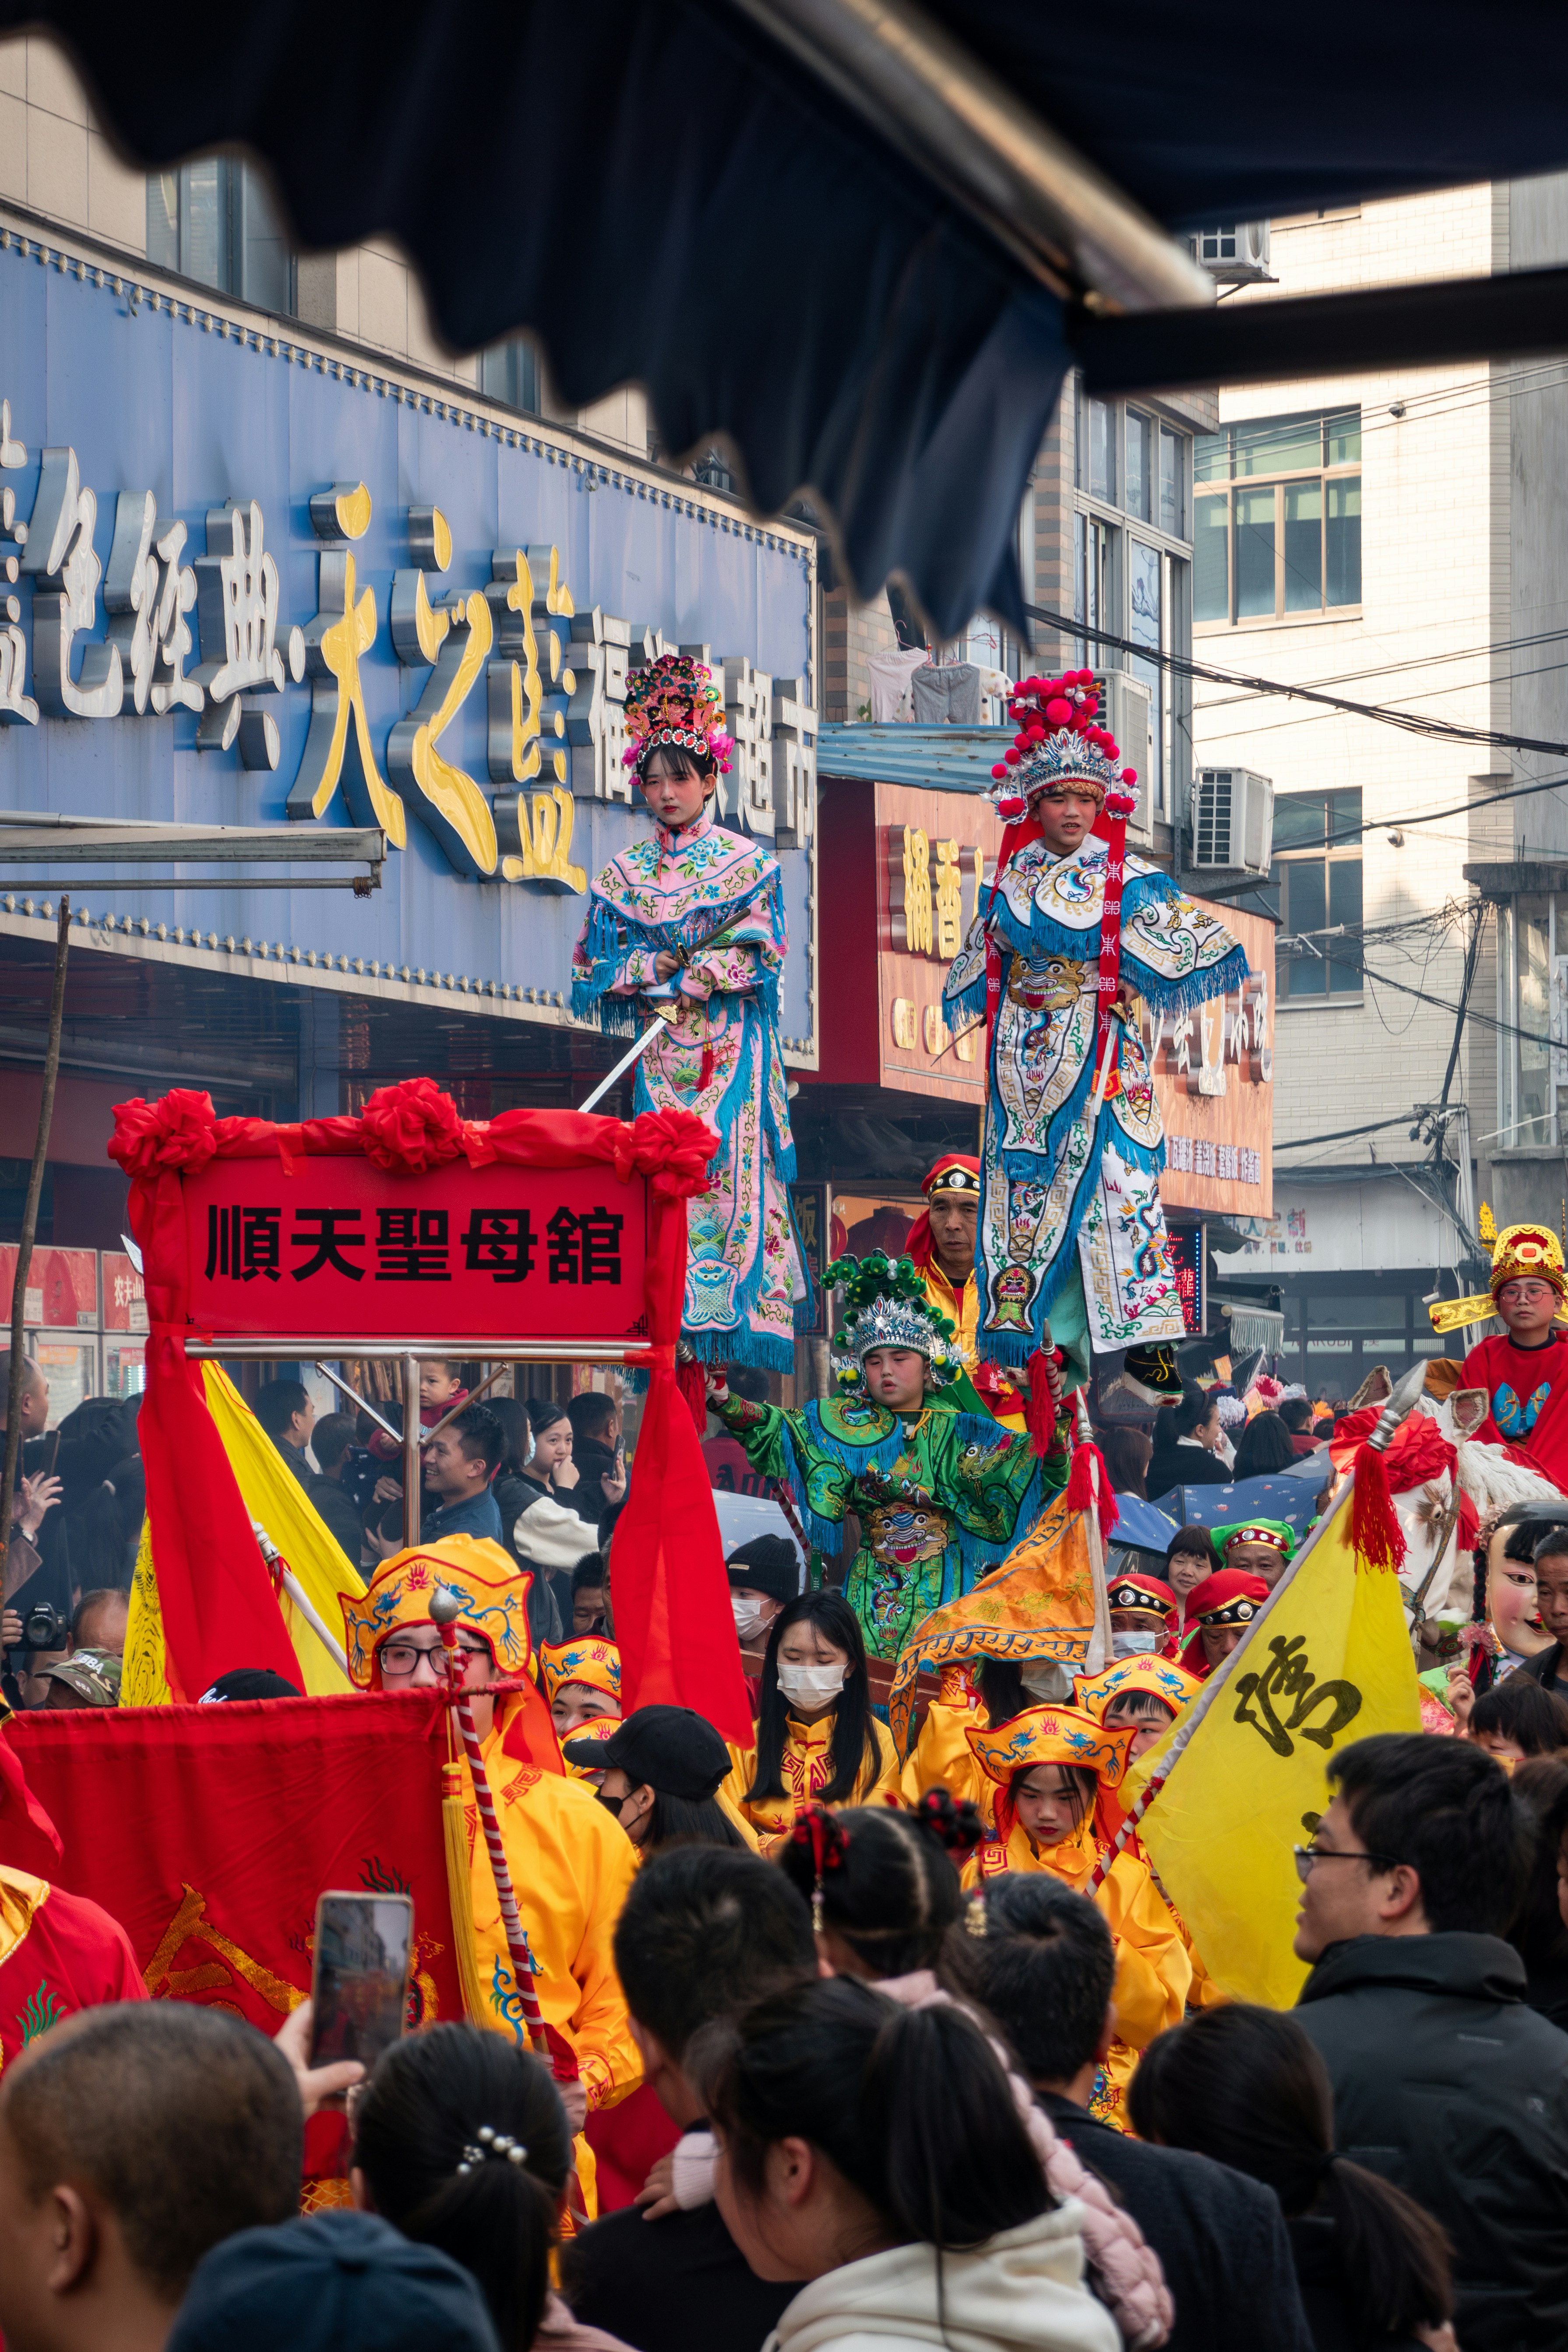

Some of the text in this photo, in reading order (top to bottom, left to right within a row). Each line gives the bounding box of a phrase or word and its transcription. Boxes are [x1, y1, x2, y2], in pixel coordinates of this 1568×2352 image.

[587, 604, 818, 850] 福超市
[1195, 1139, 1216, 1178] 盖浇饭
[1217, 1144, 1238, 1180] 套餐饭
[1240, 1147, 1261, 1185] 炸酱面
[114, 1274, 144, 1307] 农夫山
